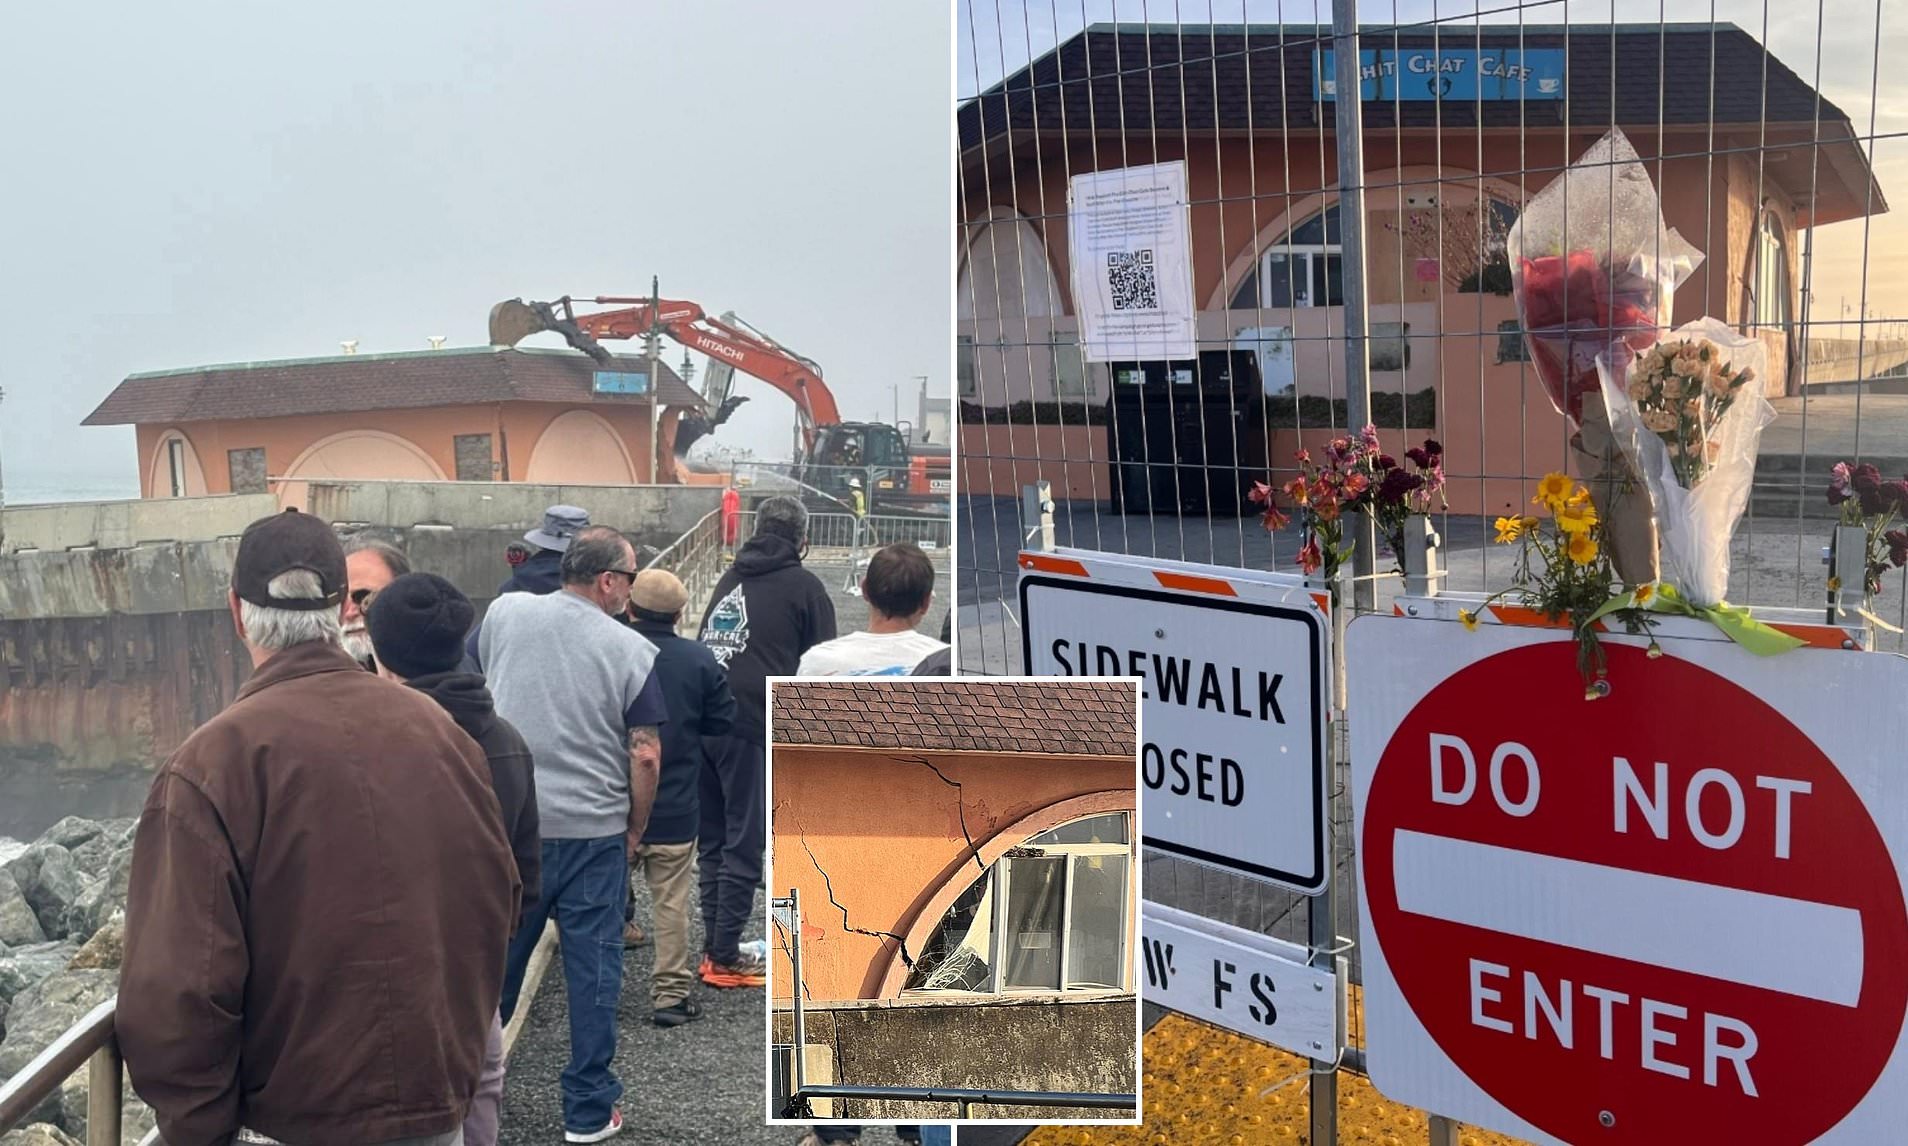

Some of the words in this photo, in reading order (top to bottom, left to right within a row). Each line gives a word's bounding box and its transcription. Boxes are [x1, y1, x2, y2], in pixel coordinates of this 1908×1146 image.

[1359, 61, 1395, 80] HIT
[696, 335, 745, 361] HITACHI
[1051, 638, 1286, 724] SIDEWALK
[1142, 742, 1245, 807] OSED
[1429, 732, 1541, 817] DO
[1612, 757, 1812, 859] NOT
[1213, 959, 1278, 1026] FS
[1468, 957, 1760, 1098] ENTER
